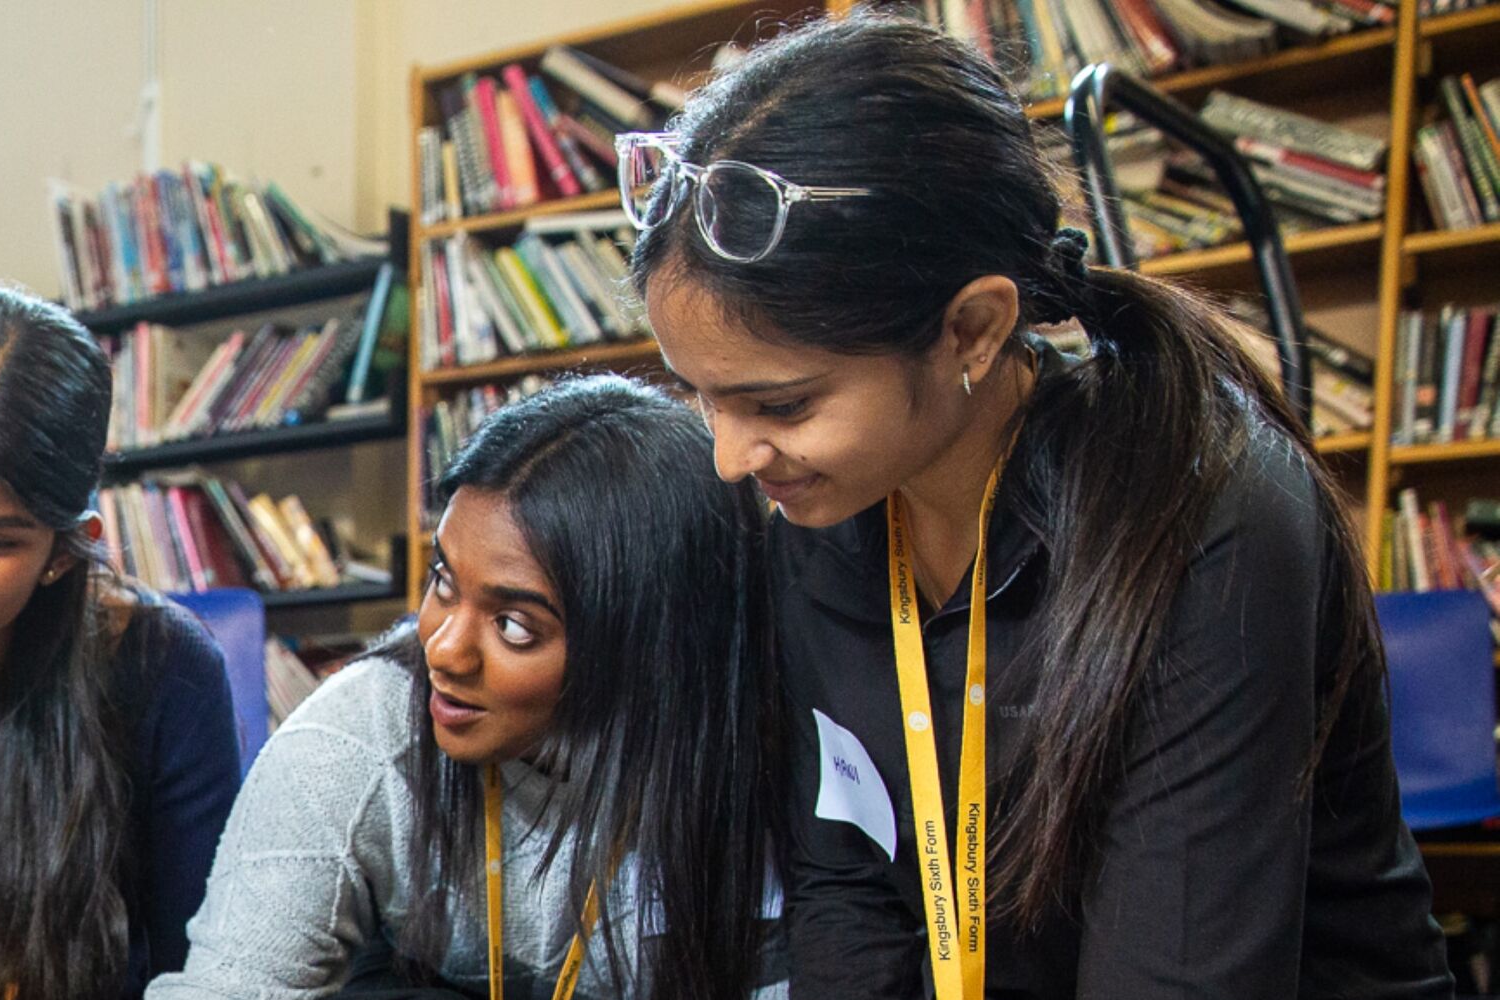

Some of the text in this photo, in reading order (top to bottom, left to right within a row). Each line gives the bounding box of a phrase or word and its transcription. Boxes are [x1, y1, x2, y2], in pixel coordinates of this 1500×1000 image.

[894, 526, 905, 558] Sixth
[898, 560, 911, 625] Kingsbury
[925, 820, 951, 961] Kingsbury Sixth Form
[964, 803, 981, 953] Kingsbury Sixth Form
